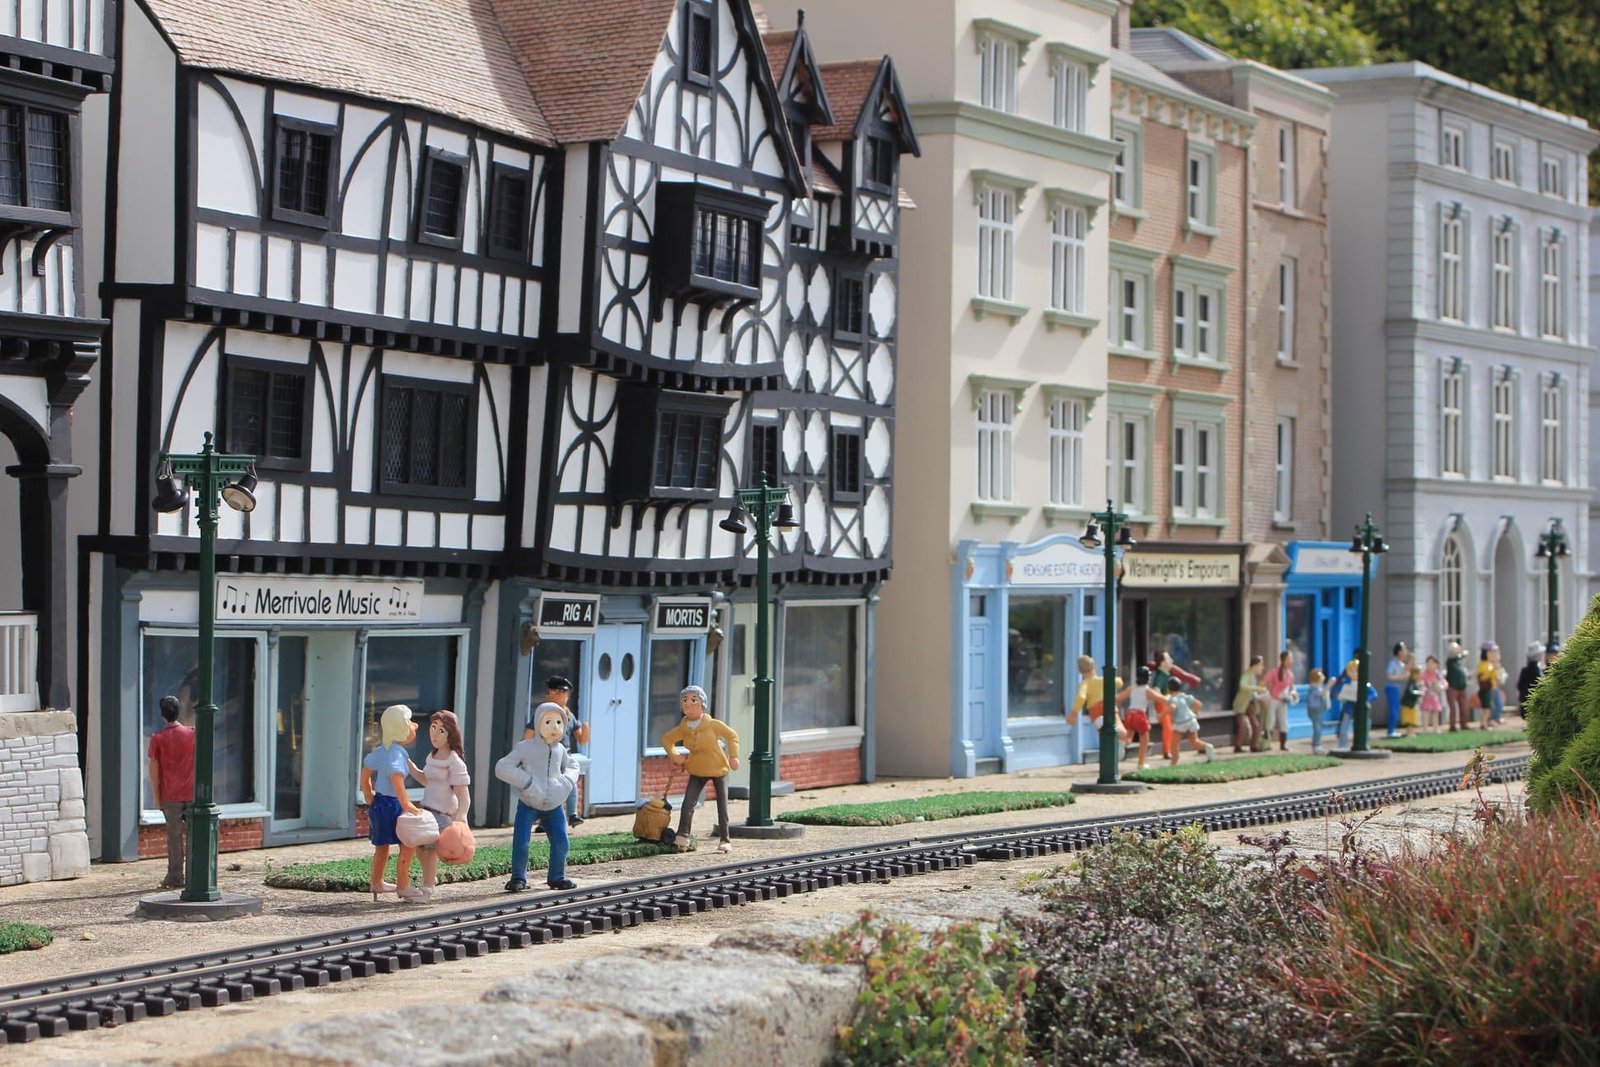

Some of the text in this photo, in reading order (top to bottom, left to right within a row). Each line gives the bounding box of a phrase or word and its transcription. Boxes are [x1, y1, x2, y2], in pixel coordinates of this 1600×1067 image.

[1054, 562, 1078, 577] ESTATE
[1129, 558, 1231, 582] Wainwright's Emporium
[254, 587, 381, 615] Merrivale Music
[562, 603, 592, 622] RIG A
[665, 608, 703, 626] MORTIS
